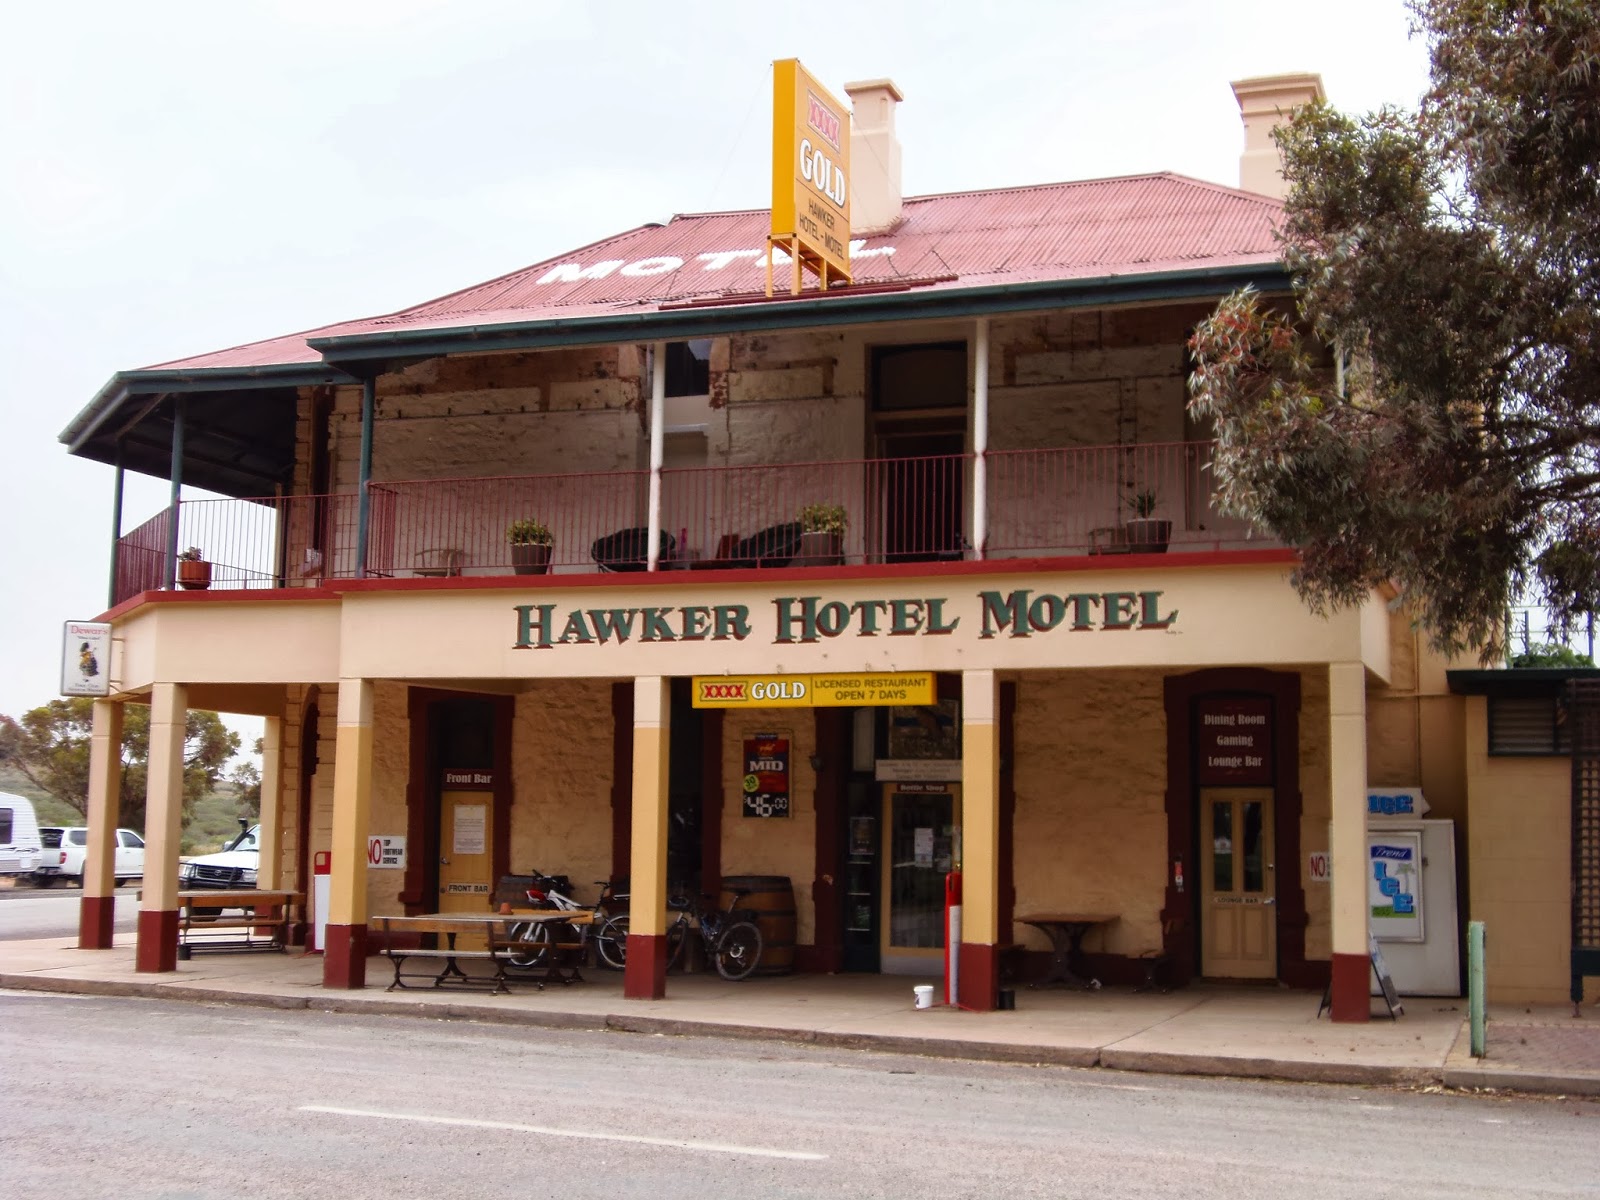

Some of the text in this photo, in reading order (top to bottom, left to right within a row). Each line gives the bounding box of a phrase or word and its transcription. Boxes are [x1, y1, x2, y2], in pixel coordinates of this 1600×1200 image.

[808, 96, 840, 149] XXXX
[799, 138, 846, 208] GOLD
[809, 197, 835, 231] HAWKER
[799, 211, 819, 242] HOTEL
[824, 233, 844, 260] MOTEL
[512, 589, 1180, 649] HAWKER HOTEL MOTEL
[703, 681, 806, 700] XXXX GOLD
[814, 677, 927, 689] LICENSED RESTAURANT
[835, 689, 906, 700] OPEN 7 DAYS
[1204, 714, 1265, 726] Dining Room
[1216, 735, 1253, 747] Gaming
[749, 760, 784, 772] MID
[1208, 756, 1262, 768] Lounge Bar
[446, 773, 492, 783] Front Bar
[1368, 794, 1414, 815] ICE
[1376, 847, 1407, 858] Trend
[1310, 856, 1326, 877] NO
[449, 884, 471, 892] FRONT
[1373, 860, 1414, 914] ICE
